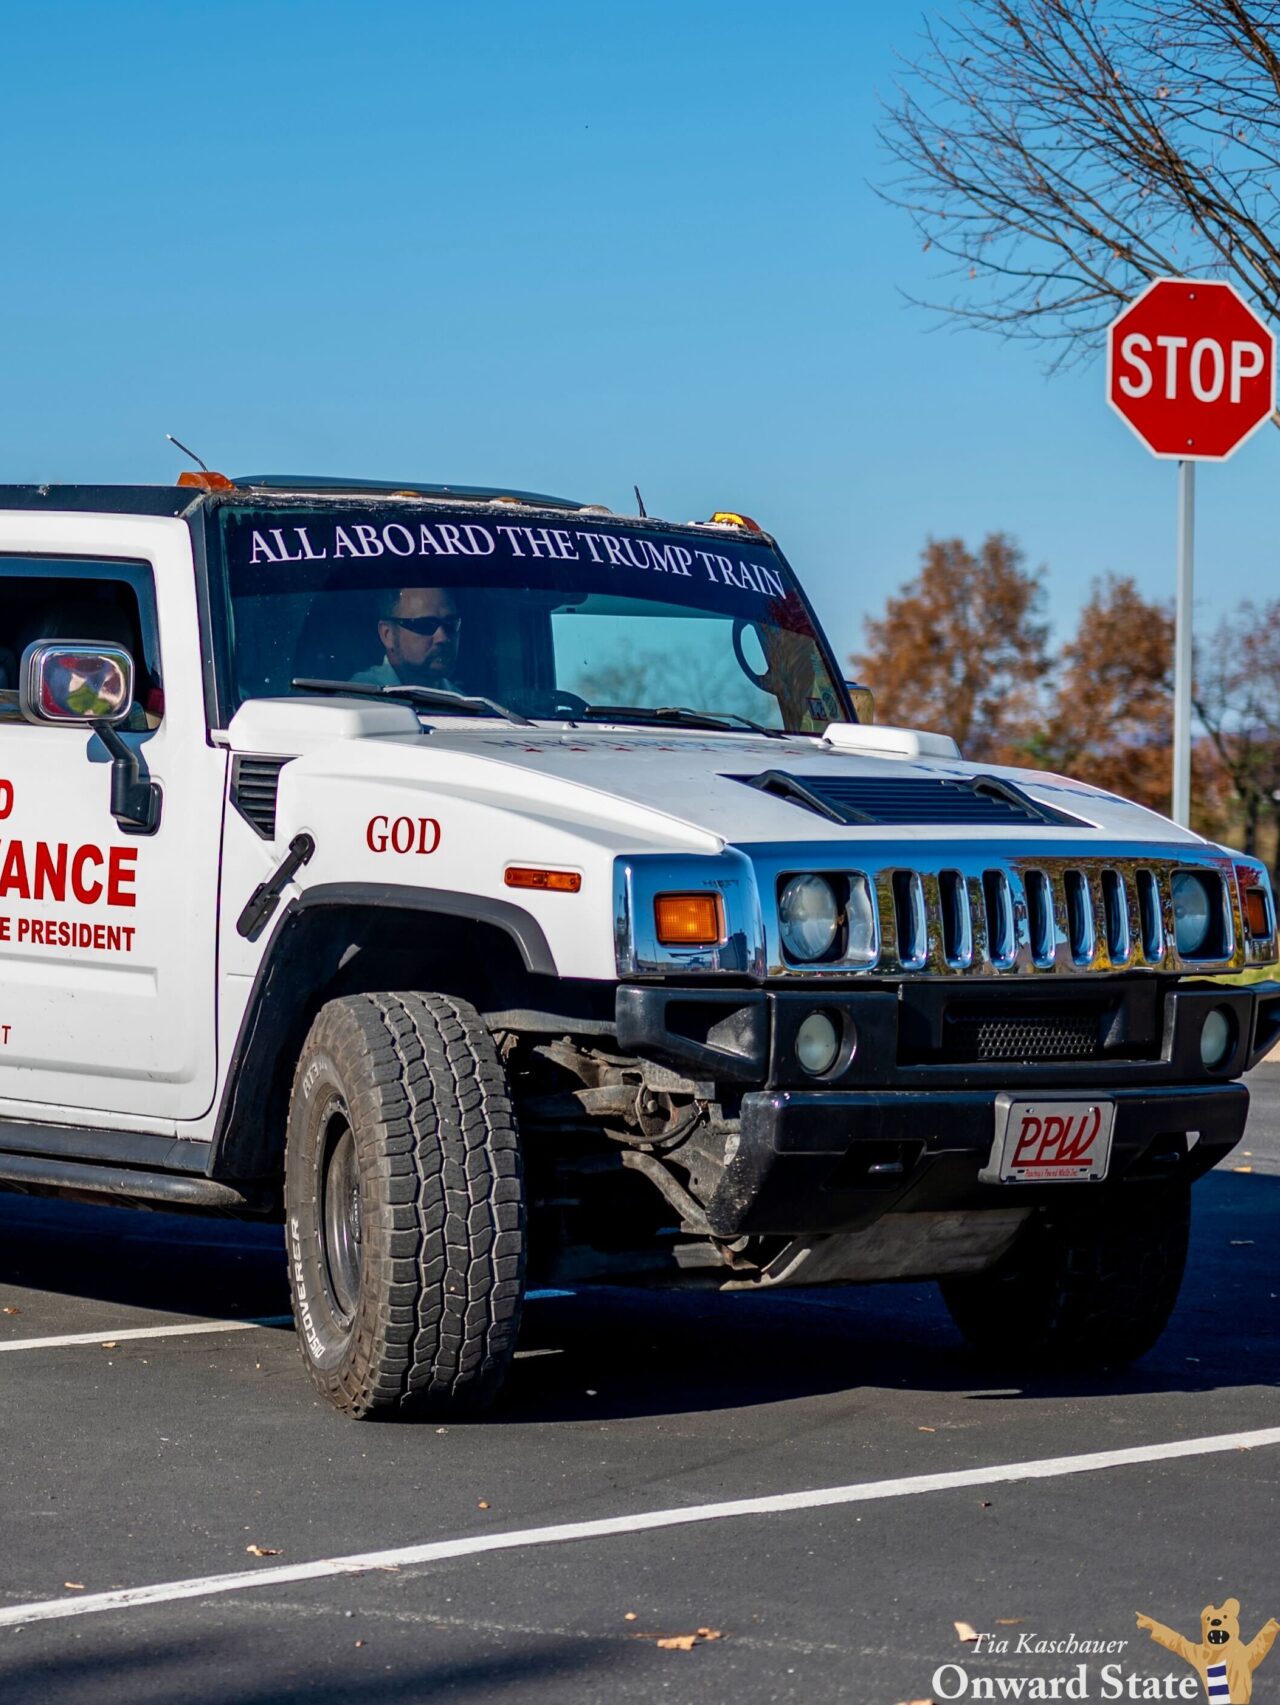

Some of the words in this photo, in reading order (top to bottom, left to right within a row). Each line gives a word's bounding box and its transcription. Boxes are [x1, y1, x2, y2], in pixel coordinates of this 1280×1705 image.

[1119, 332, 1265, 404] STOP
[249, 528, 326, 565] ALL
[333, 523, 495, 558] ABOARD
[496, 525, 580, 561] THE
[575, 531, 693, 577] TRUMP
[694, 550, 787, 600] TRAIN
[366, 815, 441, 854] GOD
[18, 918, 136, 952] PRESIDENT
[1011, 1106, 1101, 1168] PPW
[291, 1217, 326, 1360] DISCOVERER
